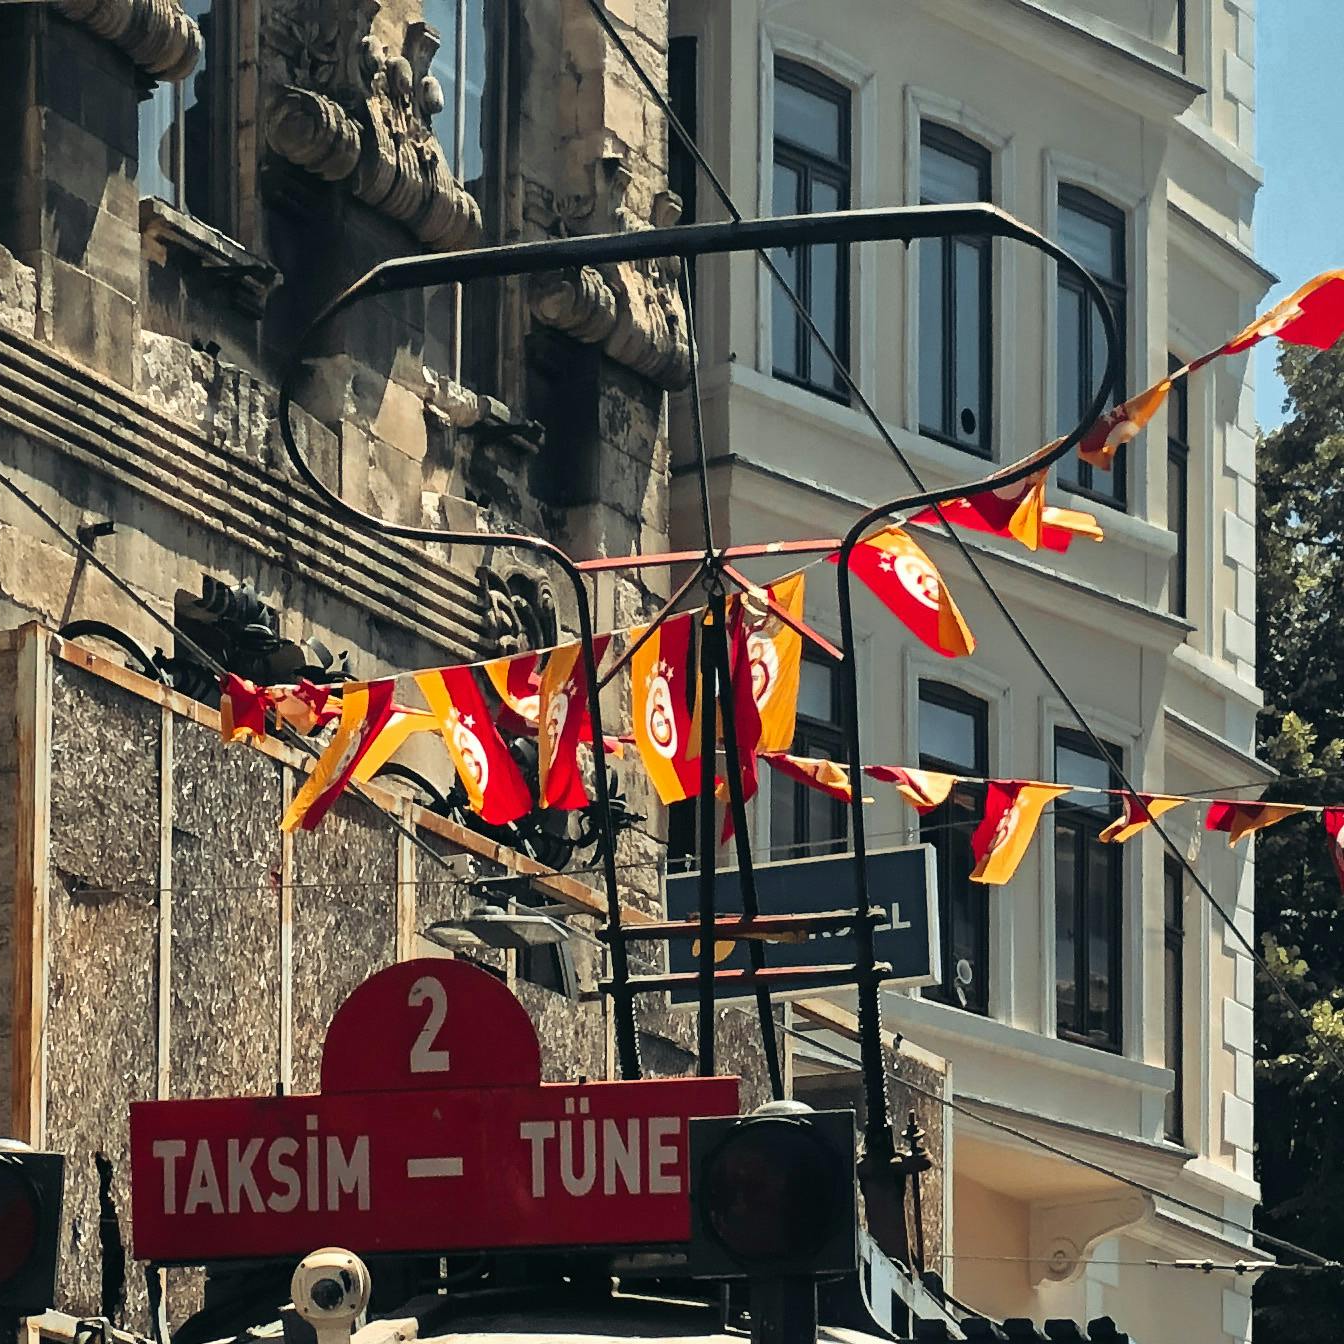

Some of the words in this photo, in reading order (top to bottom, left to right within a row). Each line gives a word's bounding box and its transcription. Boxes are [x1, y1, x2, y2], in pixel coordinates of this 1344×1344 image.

[408, 976, 450, 1073] 2
[152, 1114, 371, 1215] TAKSİM
[520, 1096, 681, 1199] TÜNE
